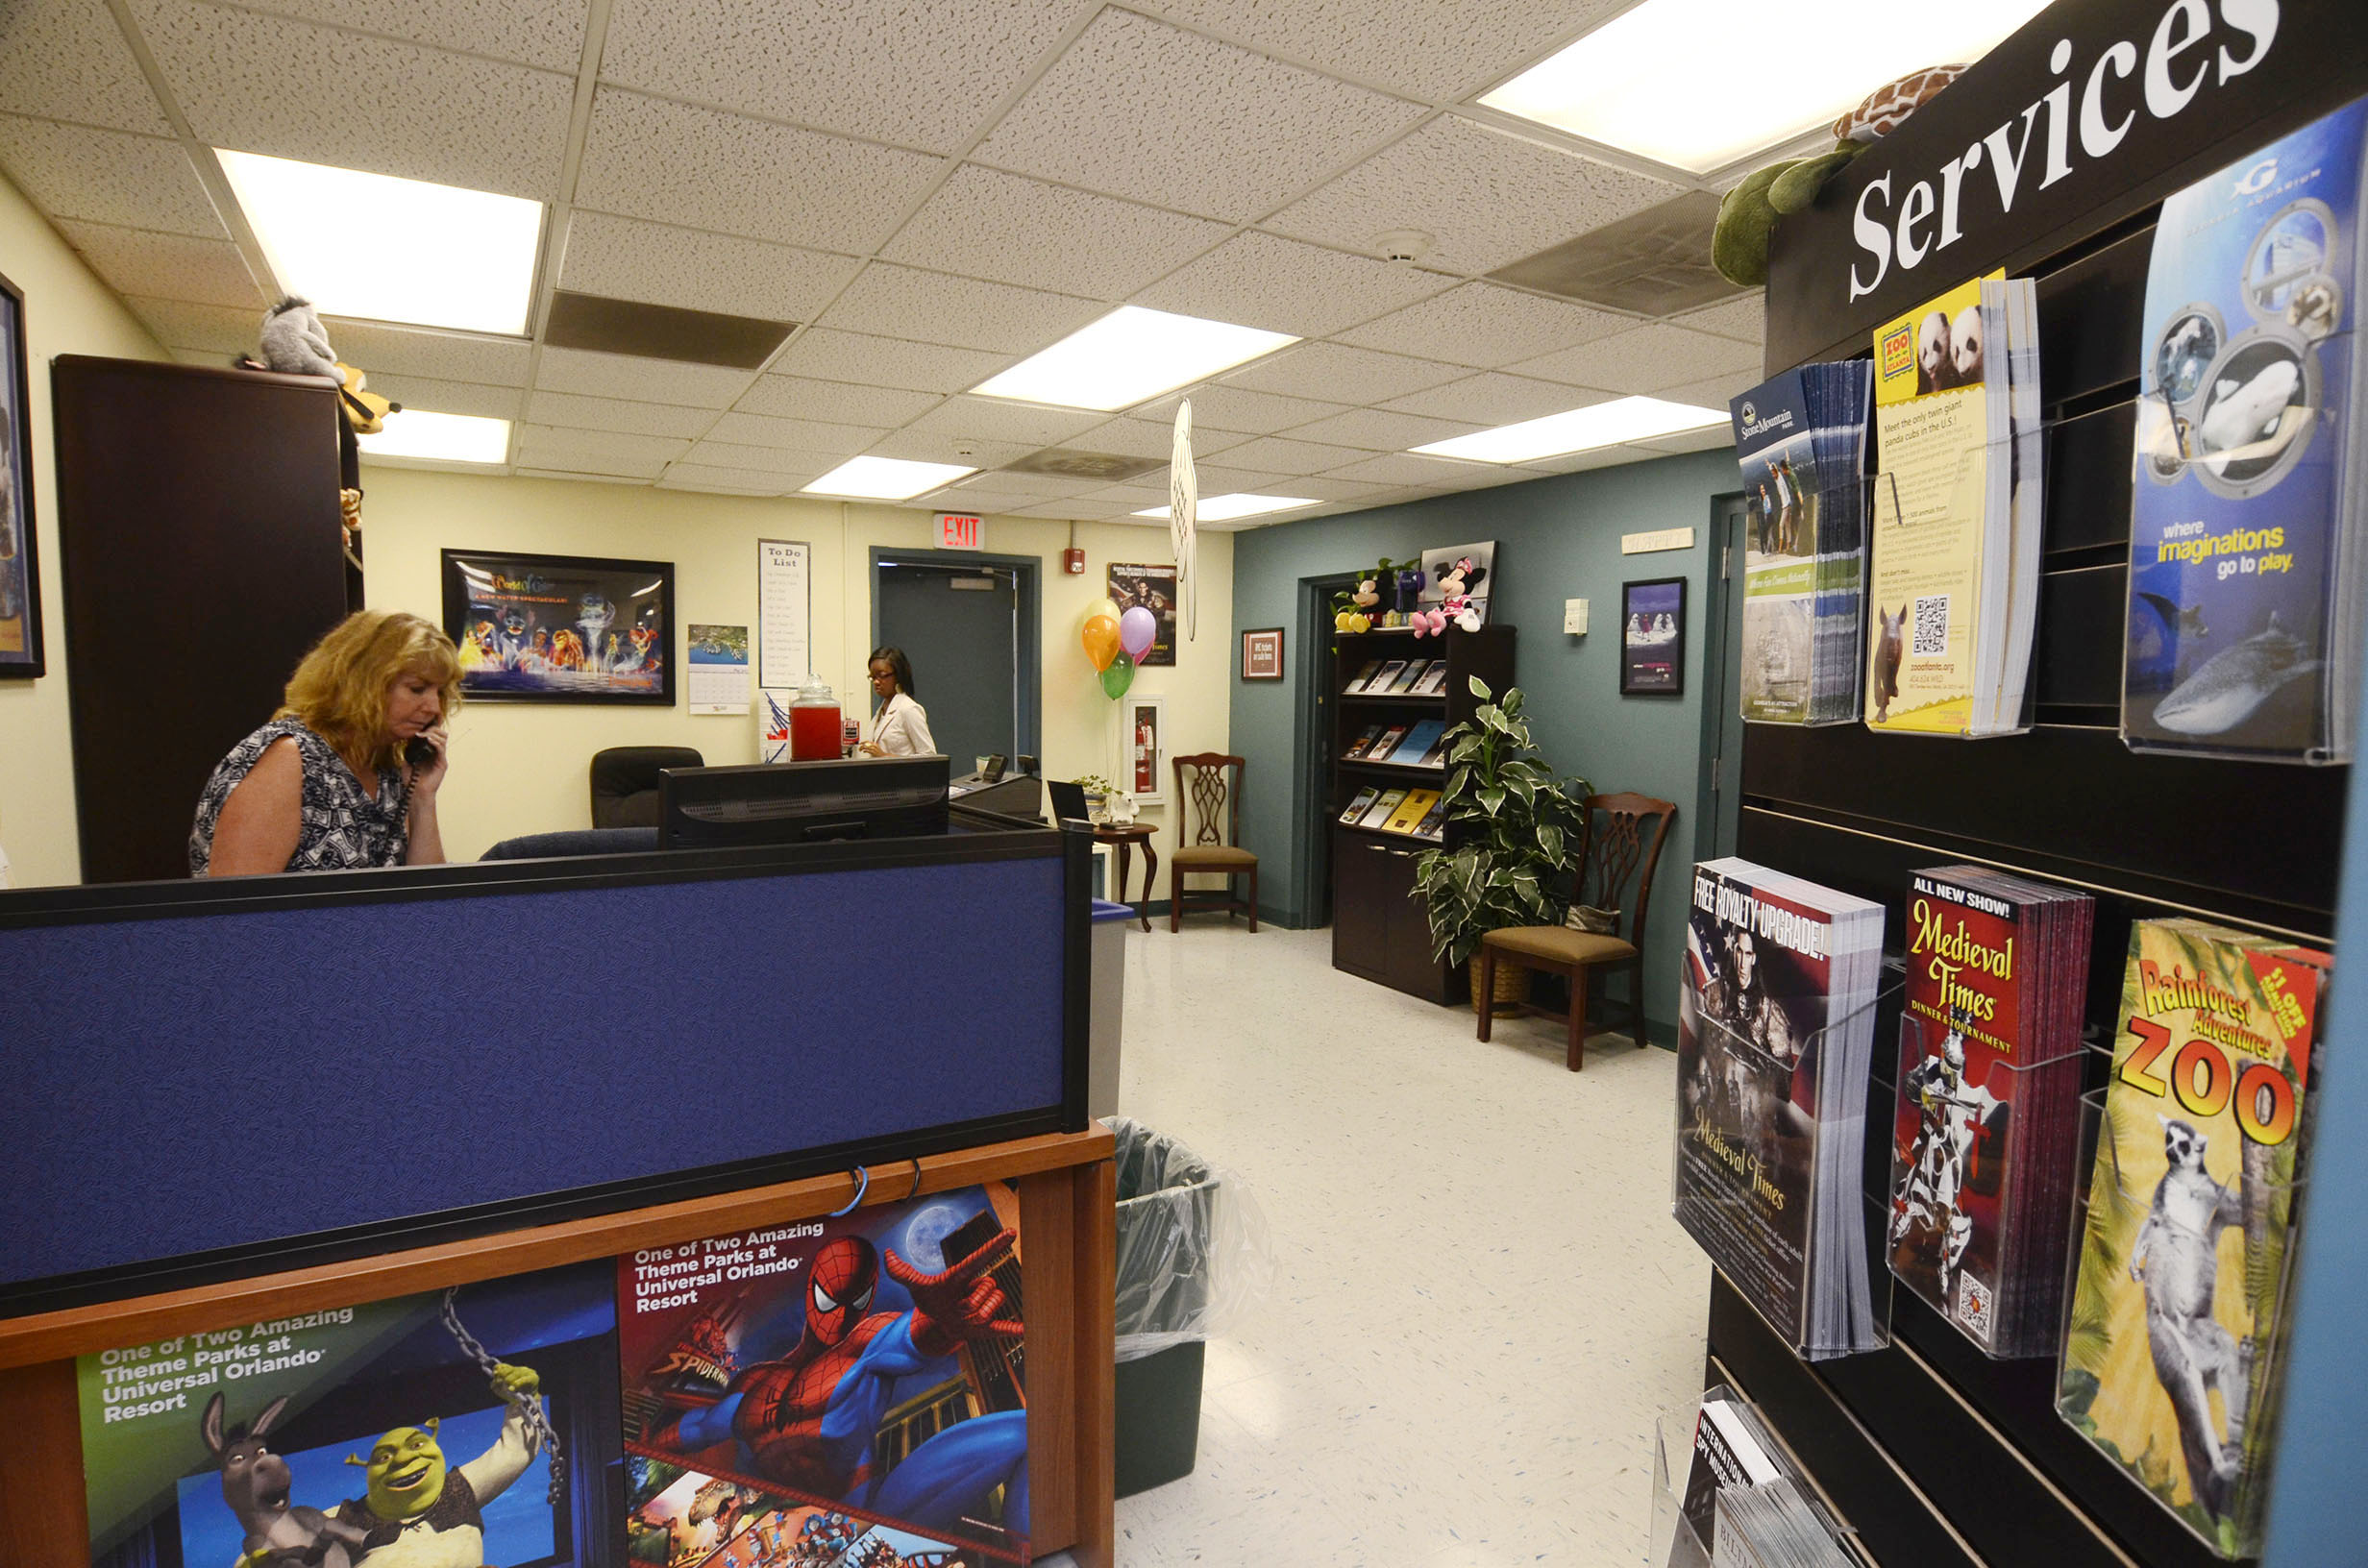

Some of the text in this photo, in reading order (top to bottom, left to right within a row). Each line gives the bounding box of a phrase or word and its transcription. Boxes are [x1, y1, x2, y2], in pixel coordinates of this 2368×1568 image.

[1848, 0, 2280, 303] Services
[1887, 335, 1908, 356] ZOO
[1887, 356, 1910, 372] ATLANTA
[1884, 399, 1962, 433] Meet the only twin giant
[1885, 433, 1904, 449] panda
[1905, 429, 1920, 441] cubs
[1921, 427, 1928, 437] in
[1929, 421, 1940, 434] the
[944, 516, 979, 546] EXIT
[2158, 527, 2283, 565] imaginations
[2163, 520, 2205, 538] where
[769, 548, 801, 557] To Do
[774, 558, 797, 567] List
[2217, 561, 2236, 580] go
[2240, 555, 2256, 574] to
[1913, 877, 2010, 919] ALL NEW SHOW!
[1693, 875, 1825, 962] FREE ROYALTY UPGRADE!
[1911, 898, 2013, 981] Medieval
[1929, 956, 1995, 1021] Times
[2139, 960, 2253, 1026] Rainforest
[1912, 999, 2011, 1054] DINNER & TOURNAMENT
[2283, 992, 2306, 1028] OFF
[2191, 1009, 2273, 1060] Adventures
[2119, 1016, 2296, 1146] ZOO
[1693, 1106, 1785, 1211] Medieval Times
[635, 1222, 824, 1264] One of Two Amazing
[635, 1244, 777, 1281] Theme Parks at
[635, 1257, 800, 1297] Universal Orlando
[636, 1289, 699, 1313] Resort
[100, 1307, 354, 1365] One of Two Amazing
[101, 1335, 291, 1384] Theme Parks at
[103, 1348, 322, 1404] Universal Orlando
[104, 1393, 186, 1424] Resort
[1696, 1433, 1710, 1458] SPY
[1699, 1416, 1749, 1487] INTERNATIONA
[1709, 1452, 1736, 1490] MUSEU
